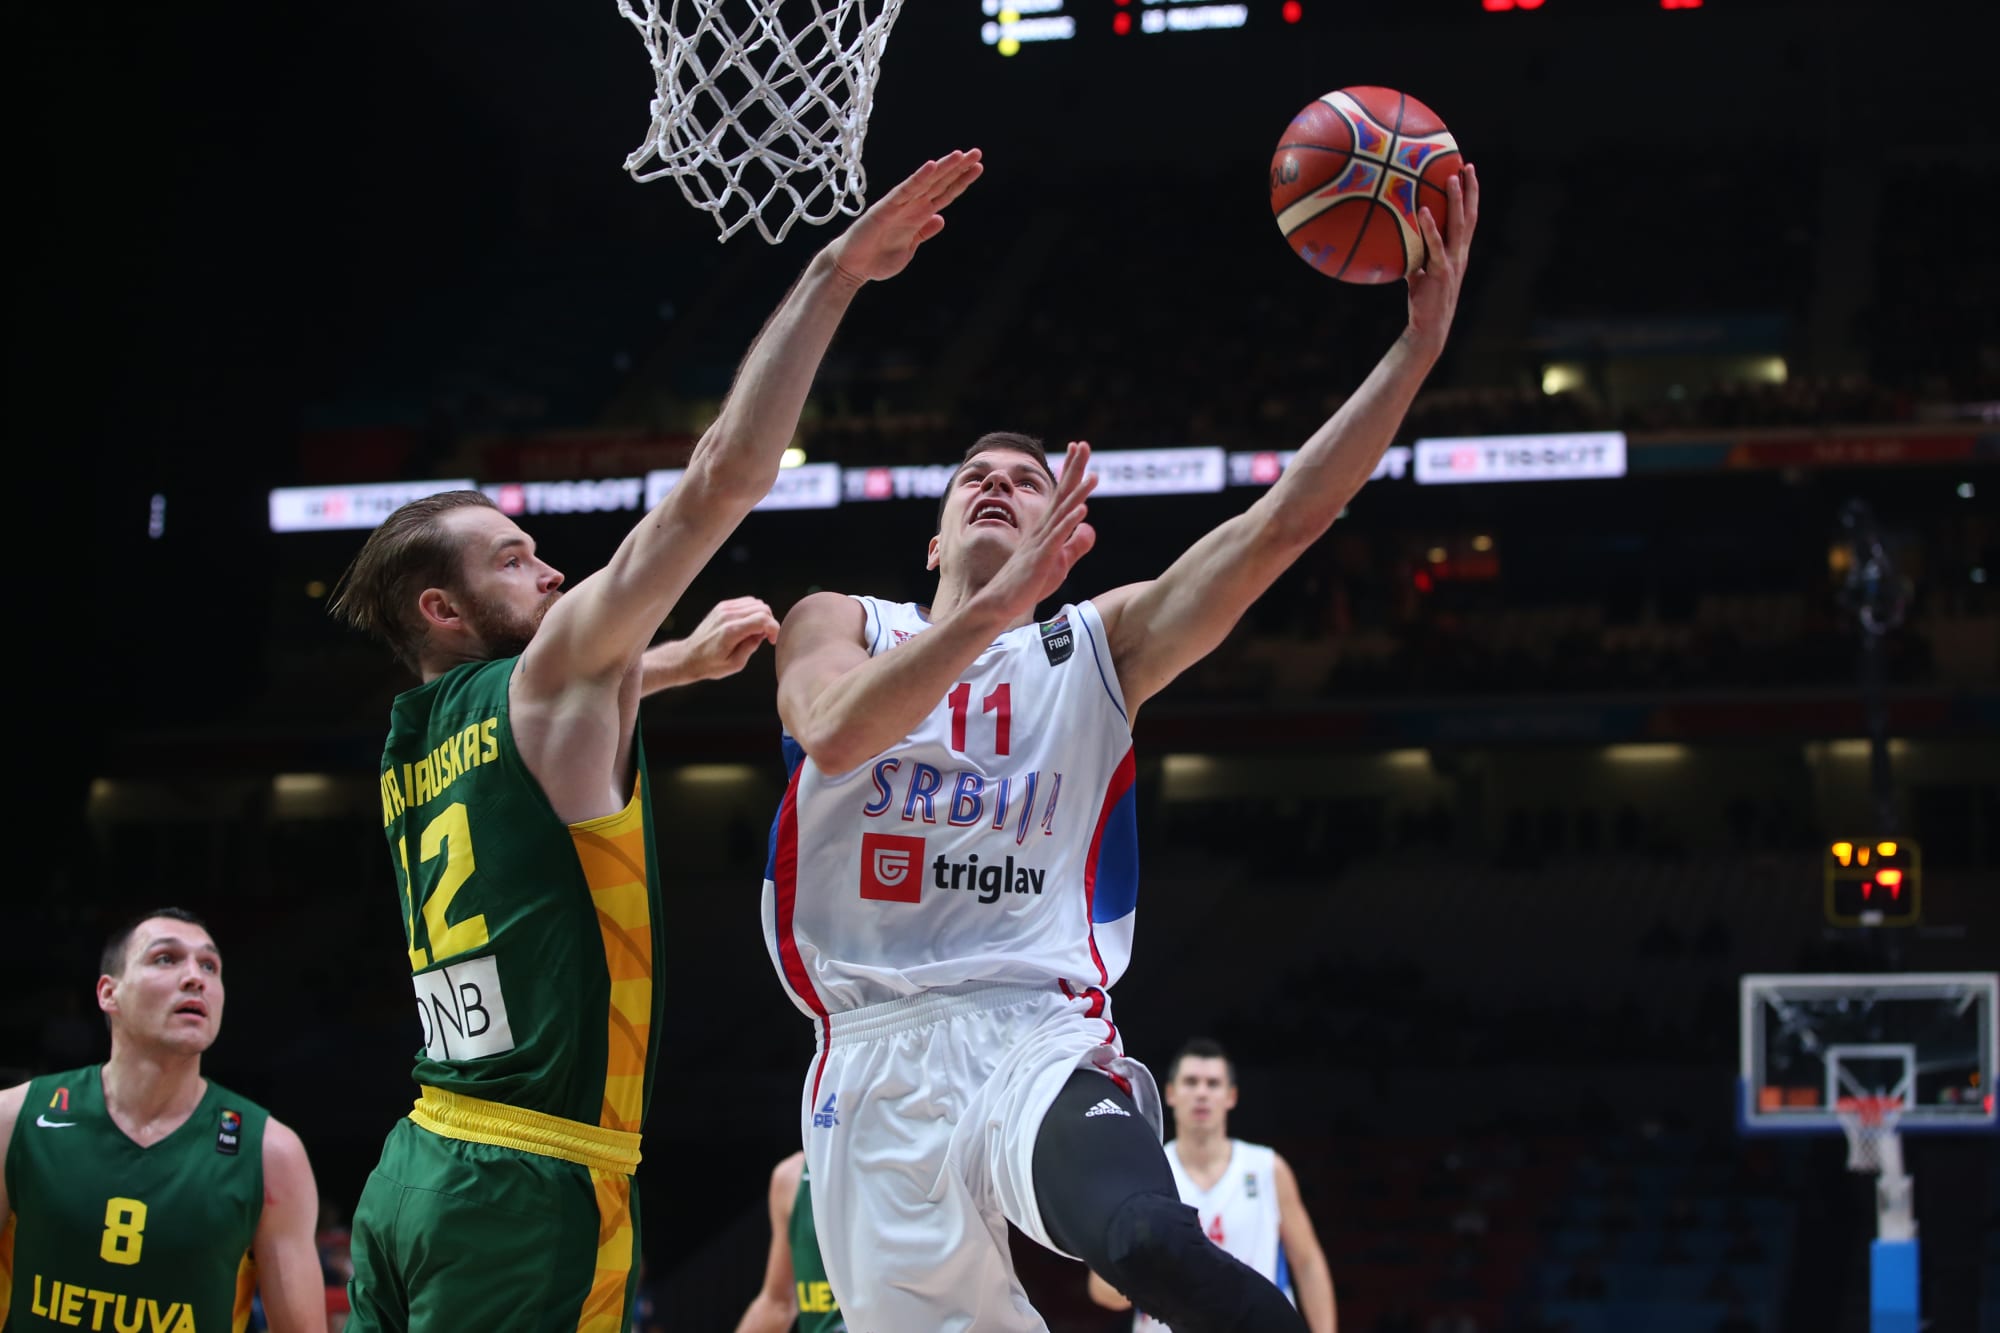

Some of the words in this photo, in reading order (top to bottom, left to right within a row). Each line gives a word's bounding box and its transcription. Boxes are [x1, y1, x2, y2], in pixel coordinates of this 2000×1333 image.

[1485, 446, 1607, 470] TISSOT
[525, 477, 643, 514] TISSOT
[1048, 634, 1070, 650] FIBA
[948, 682, 1012, 756] 11
[933, 853, 1046, 904] triglav
[1085, 1106, 1131, 1117] adidas
[100, 1196, 148, 1266] 8
[31, 1273, 197, 1333] LIETUVA
